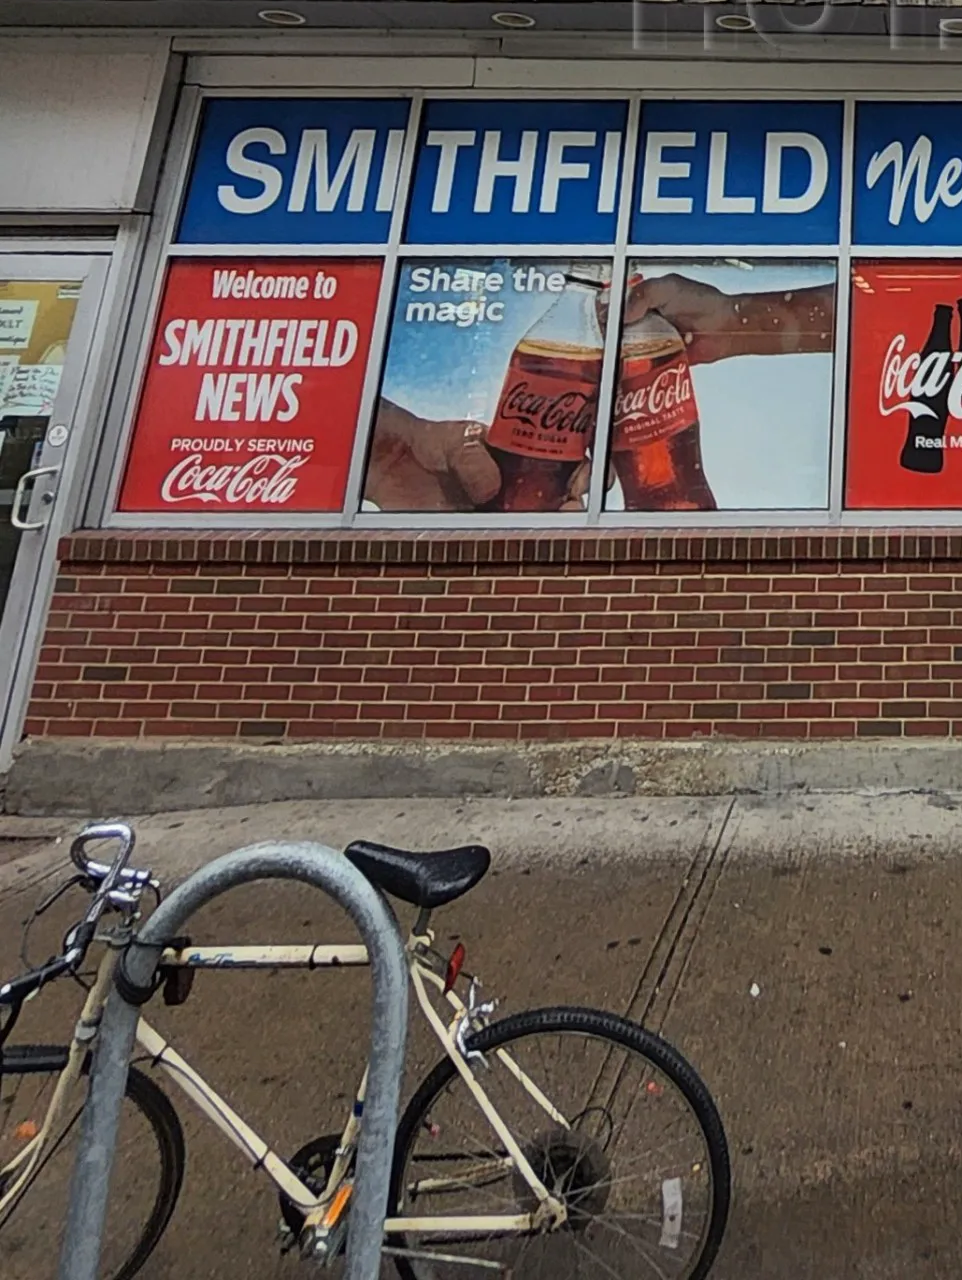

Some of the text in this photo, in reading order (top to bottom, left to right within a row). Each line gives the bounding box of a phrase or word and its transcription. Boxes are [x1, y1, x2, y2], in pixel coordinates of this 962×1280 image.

[217, 127, 829, 214] SMITHFIELD
[212, 270, 337, 300] Welcome to
[409, 267, 567, 293] Share the
[404, 300, 506, 330] magic
[159, 319, 359, 368] SMITHFIELD
[194, 373, 303, 423] NEWS
[171, 438, 314, 453] PROUDLY SERVING
[914, 435, 947, 450] Real
[161, 454, 311, 505] Coca-Cola
